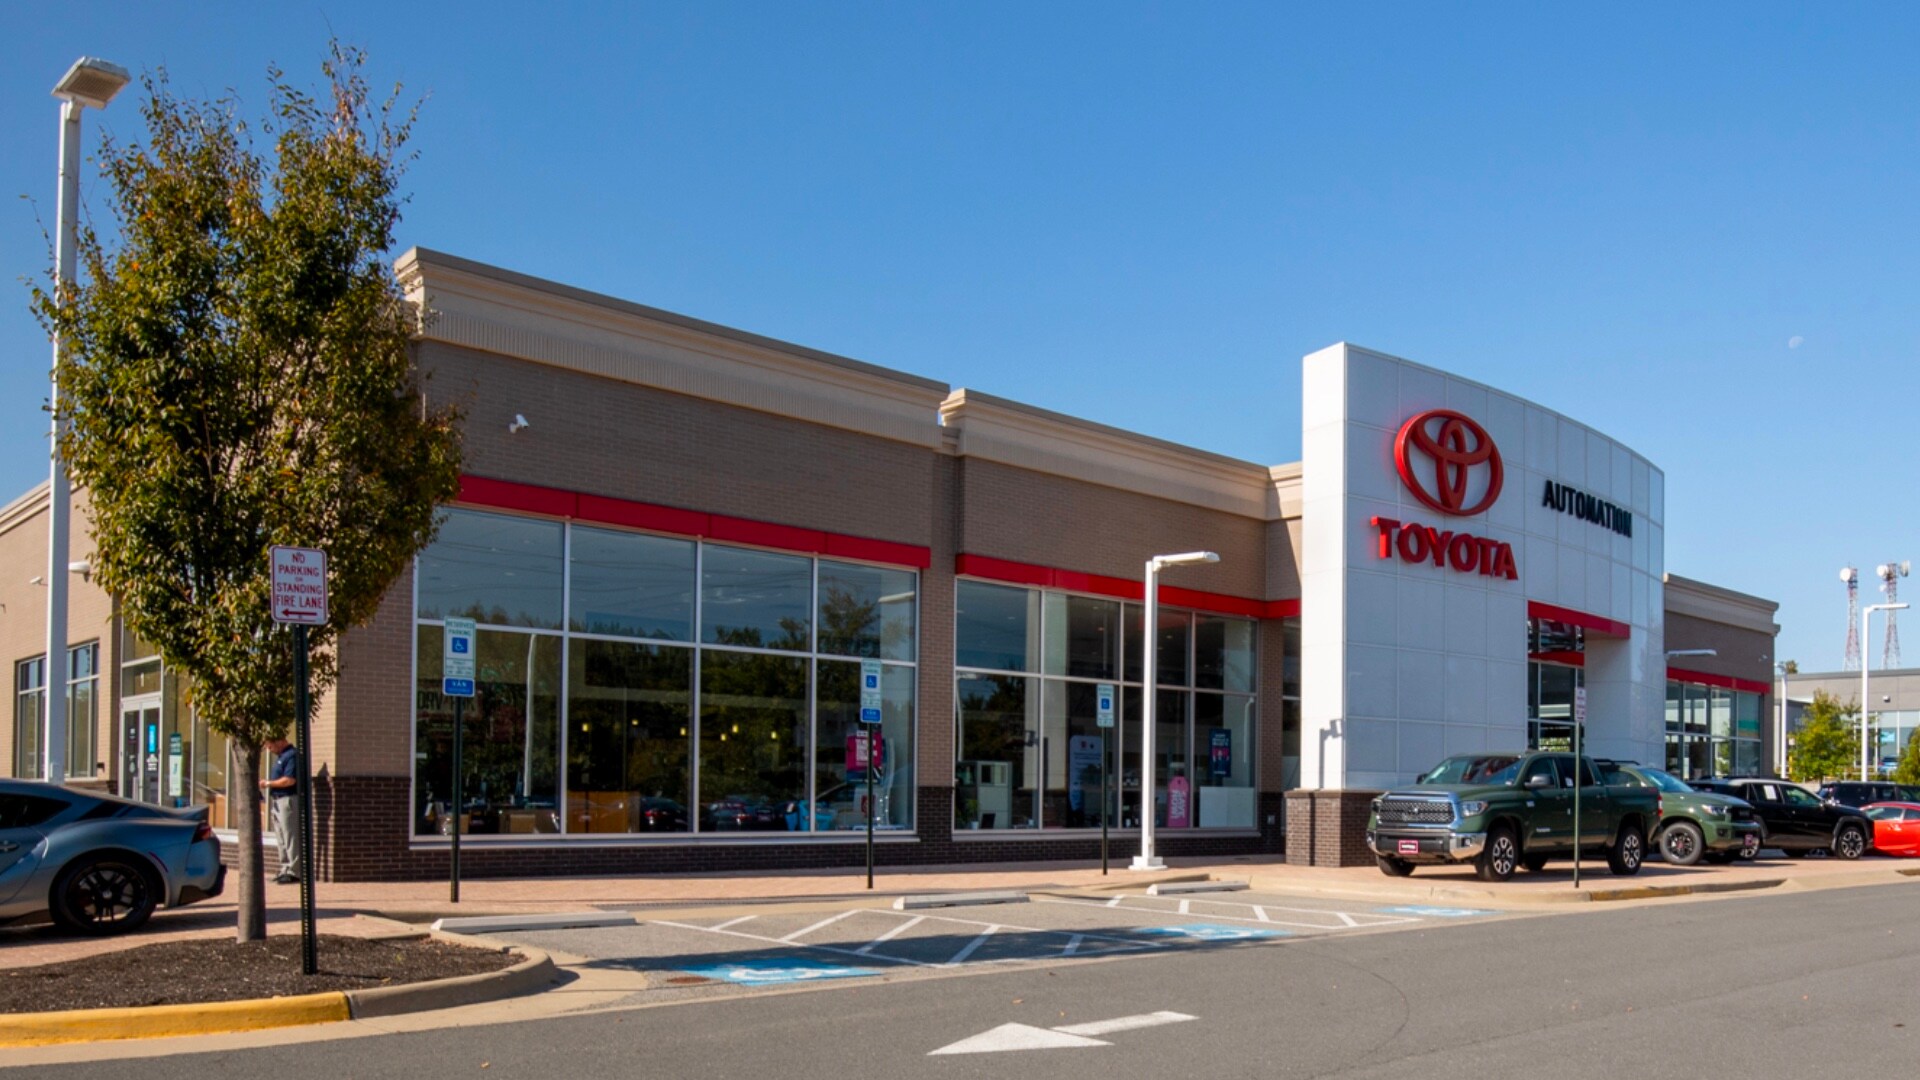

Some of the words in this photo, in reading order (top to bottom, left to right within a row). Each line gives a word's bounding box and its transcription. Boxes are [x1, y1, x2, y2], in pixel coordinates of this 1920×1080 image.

[1542, 480, 1632, 538] AUTONATION
[1370, 515, 1519, 580] TOYOTA
[292, 552, 306, 564] NO
[278, 564, 320, 577] PARKING
[276, 582, 323, 595] STANDING
[276, 594, 296, 607] FIRE
[299, 595, 323, 609] LANE
